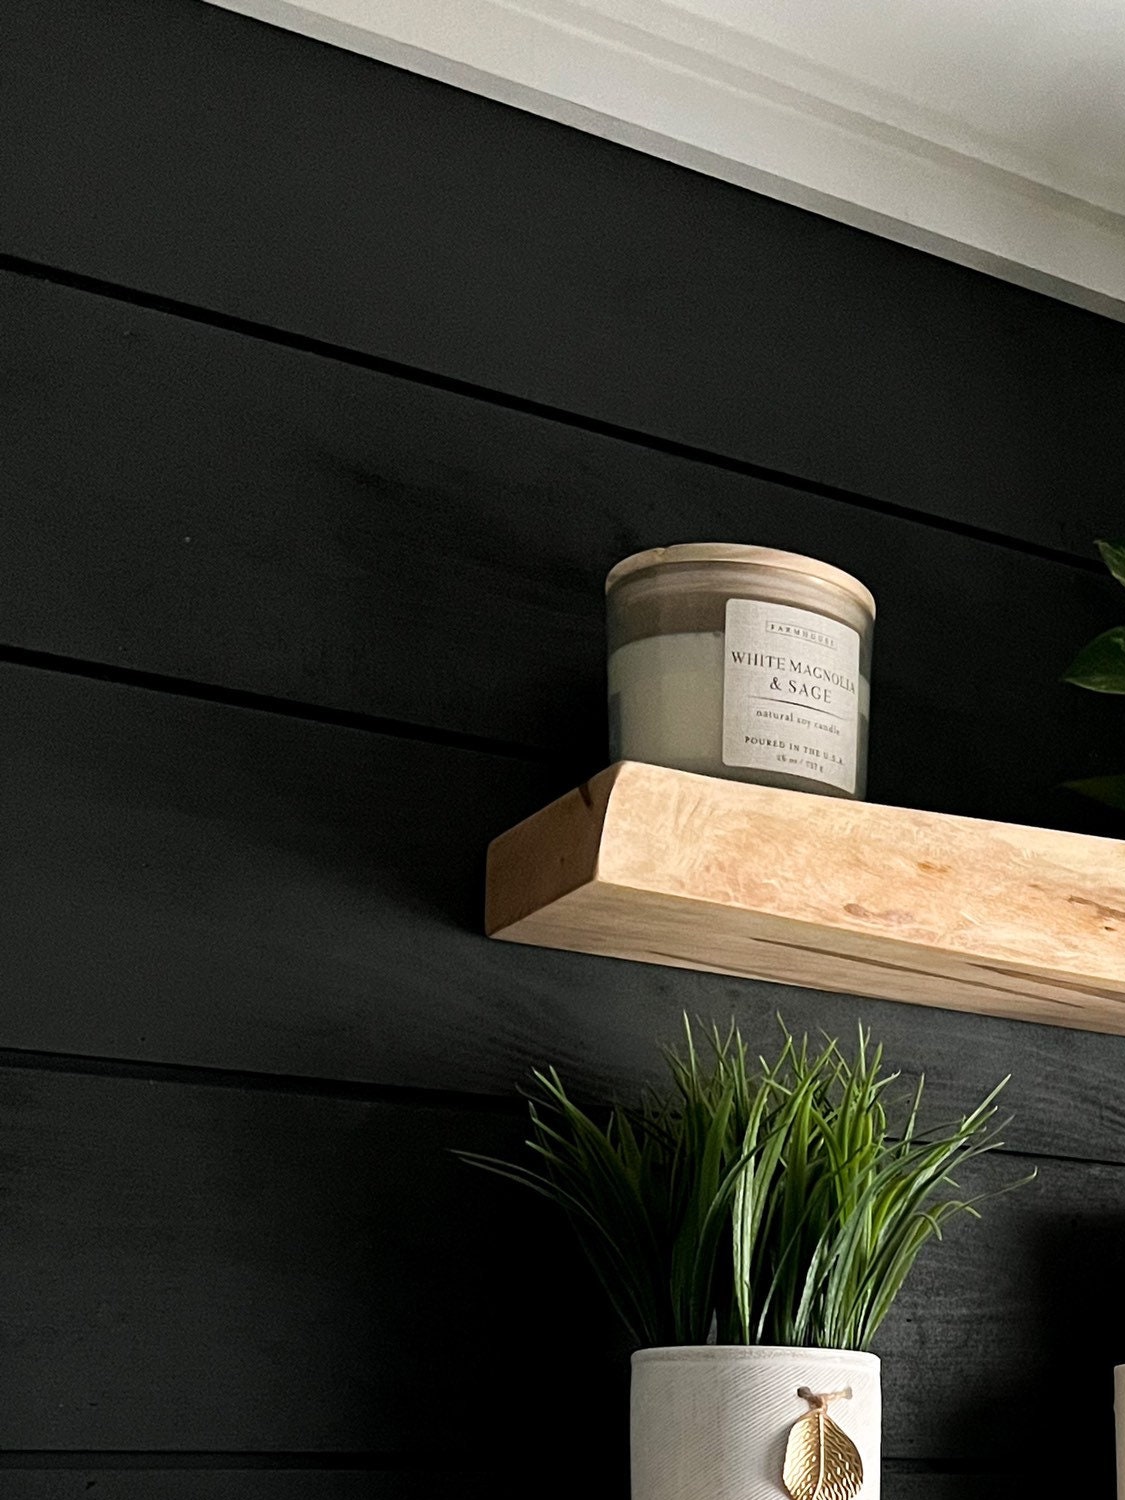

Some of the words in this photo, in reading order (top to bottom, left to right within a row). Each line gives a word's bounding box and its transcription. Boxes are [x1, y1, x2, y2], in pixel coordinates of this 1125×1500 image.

[731, 650, 786, 672] WHITE
[789, 659, 856, 695] MAGNOLIA
[769, 676, 782, 691] &
[788, 680, 832, 704] SAGE
[755, 709, 794, 722] natural
[796, 717, 811, 729] soy
[814, 721, 840, 736] candle
[744, 735, 786, 749] POURED
[789, 743, 800, 752] IN
[803, 746, 820, 757] THE
